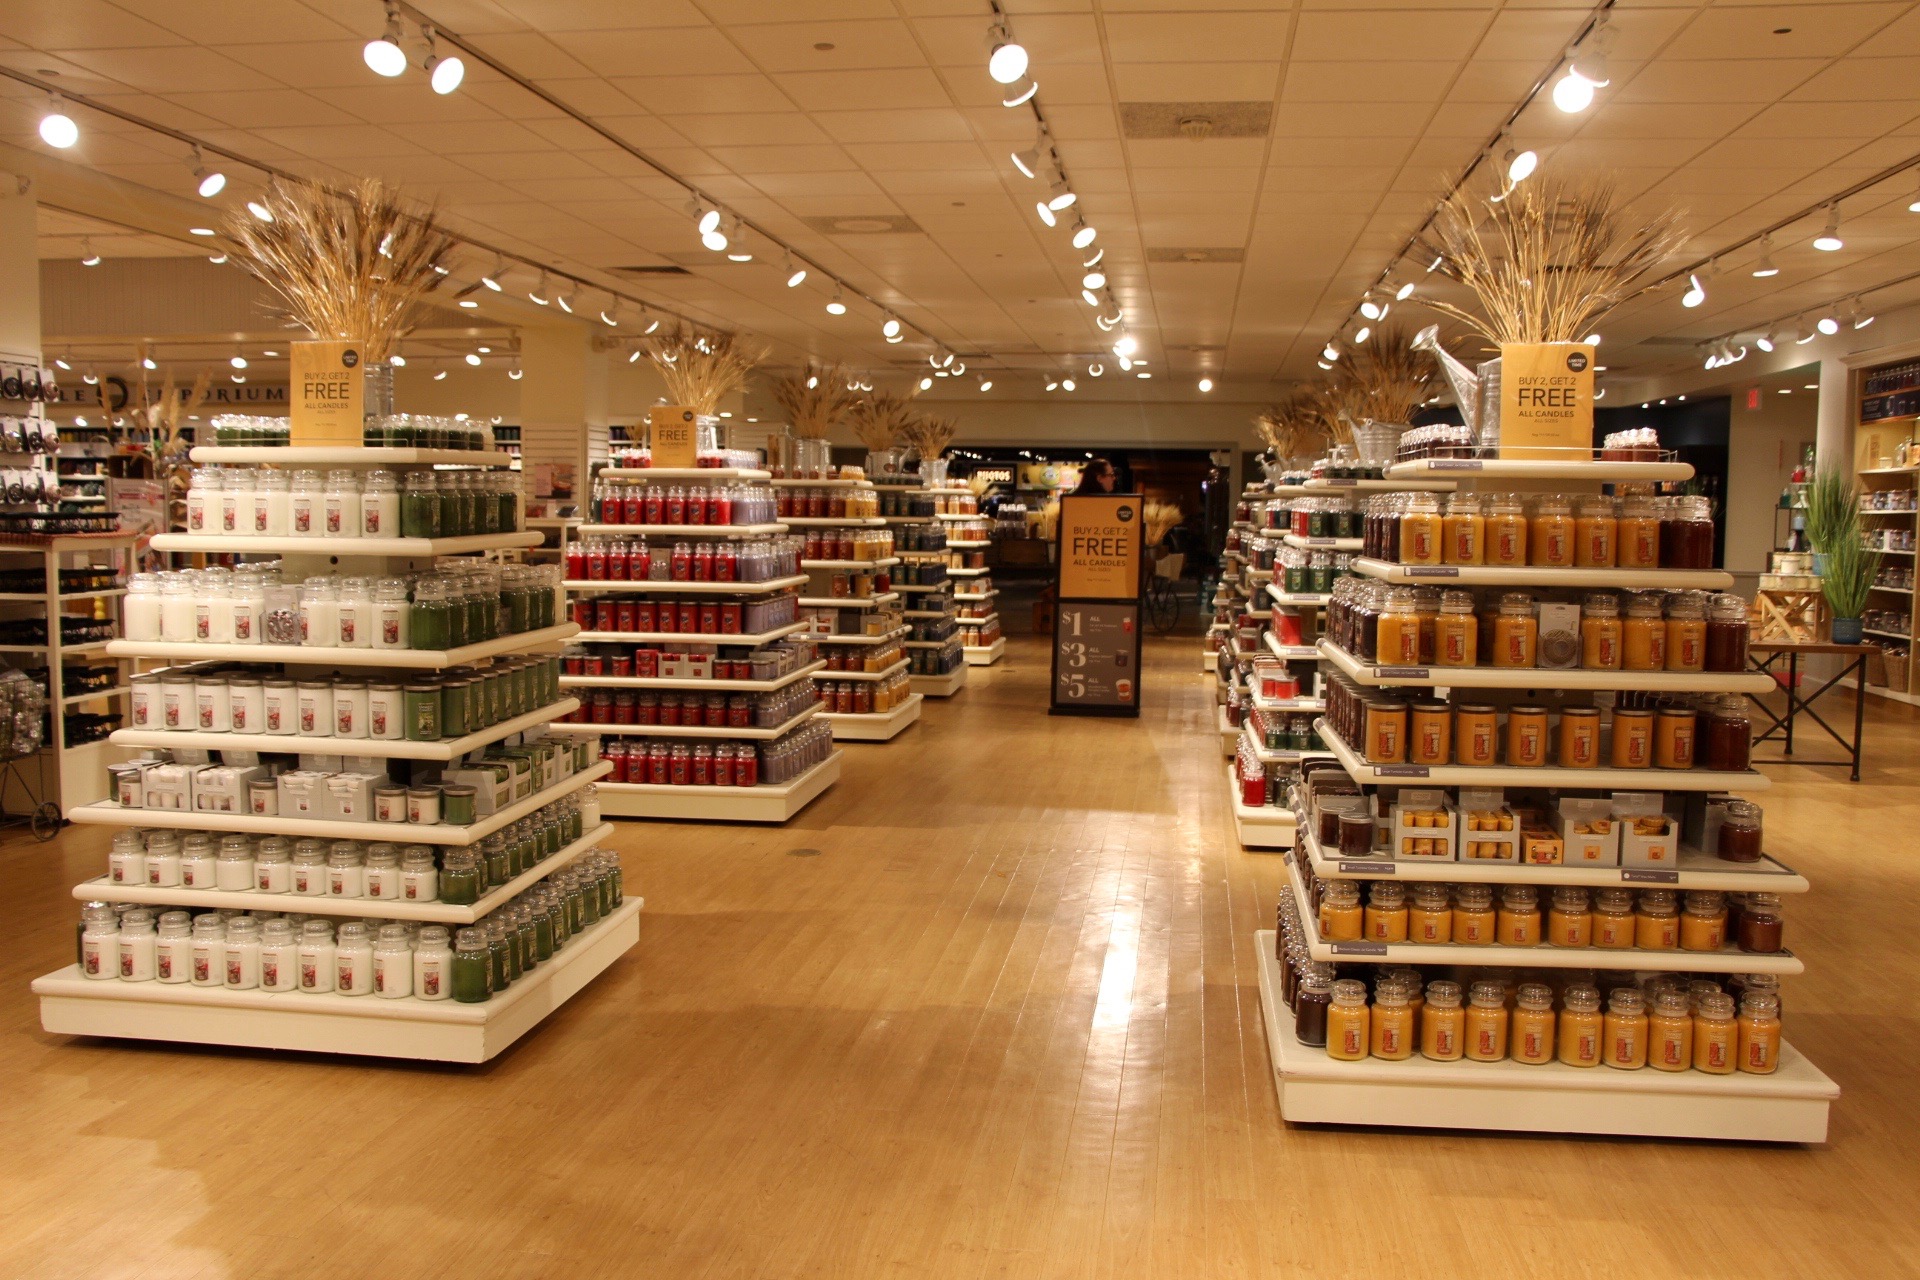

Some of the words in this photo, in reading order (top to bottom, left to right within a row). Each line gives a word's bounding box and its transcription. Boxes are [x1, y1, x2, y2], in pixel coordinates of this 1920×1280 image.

[304, 372, 320, 380] BUY
[328, 372, 344, 380] GET
[1518, 377, 1538, 385] BUY
[1540, 377, 1548, 386] 2,
[1549, 377, 1570, 385] GET
[1571, 377, 1577, 385] 2
[304, 382, 350, 400] FREE
[1518, 388, 1576, 407] FREE
[659, 430, 688, 441] FREE
[977, 470, 1010, 481] PHOTOS
[1073, 526, 1092, 535] BUY
[1102, 527, 1121, 536] GET
[1122, 527, 1128, 536] 2
[1073, 537, 1128, 557] FREE
[1089, 559, 1126, 567] CANDLES
[1062, 611, 1082, 636] $1
[1061, 642, 1086, 667] $3
[1060, 673, 1085, 698] $5
